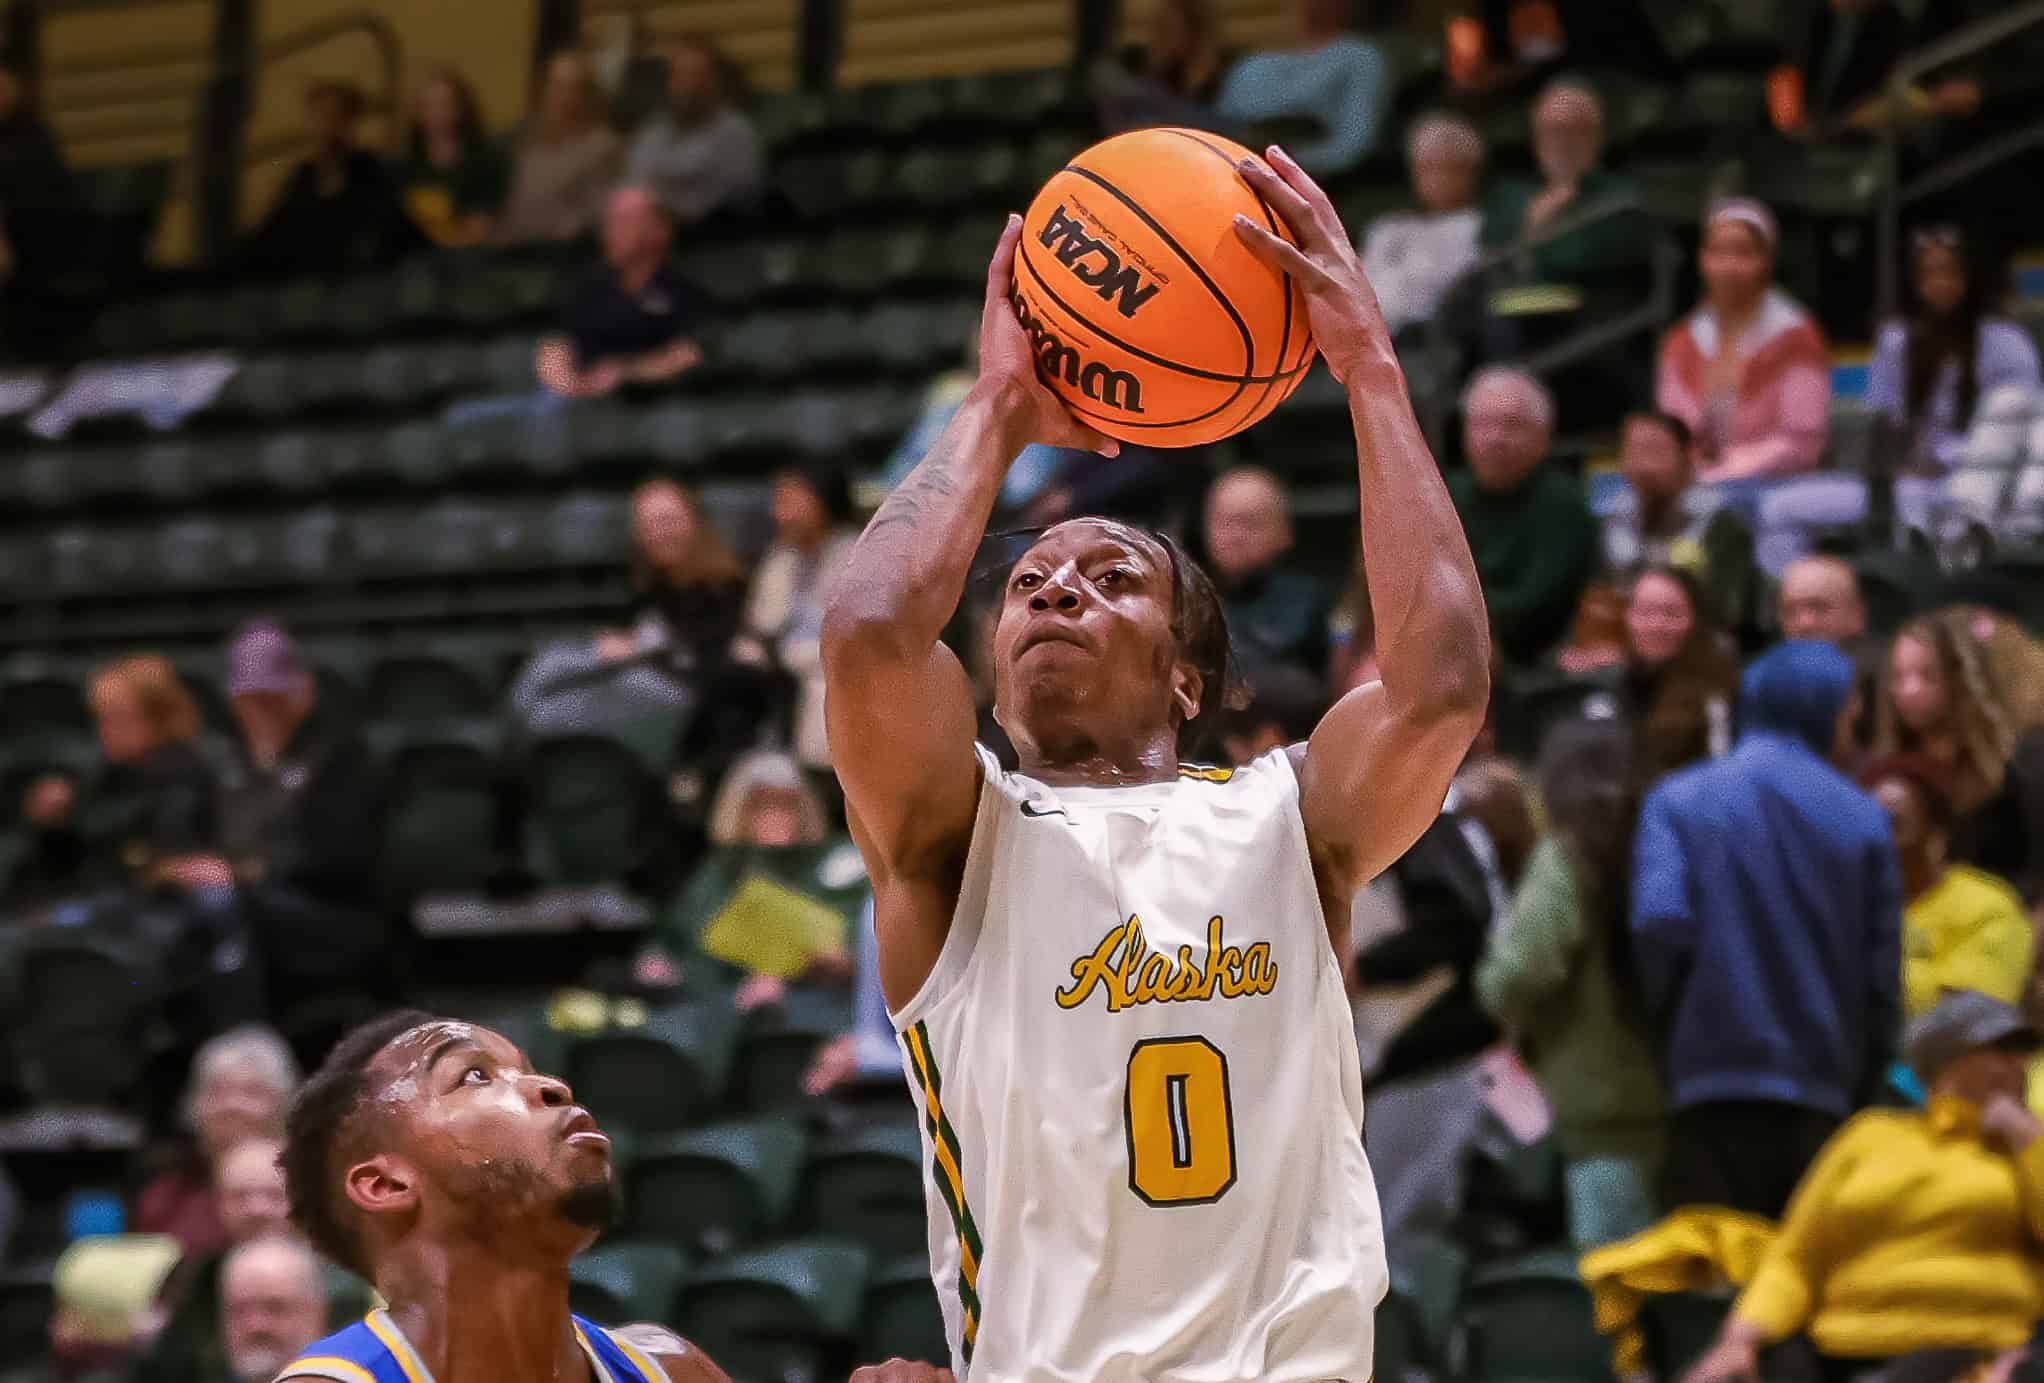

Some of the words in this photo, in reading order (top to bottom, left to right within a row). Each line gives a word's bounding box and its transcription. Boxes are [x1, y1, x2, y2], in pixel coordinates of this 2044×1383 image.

[1039, 204, 1159, 318] NCAA
[1055, 913, 1278, 1012] Alaska
[1124, 1034, 1237, 1208] 0
